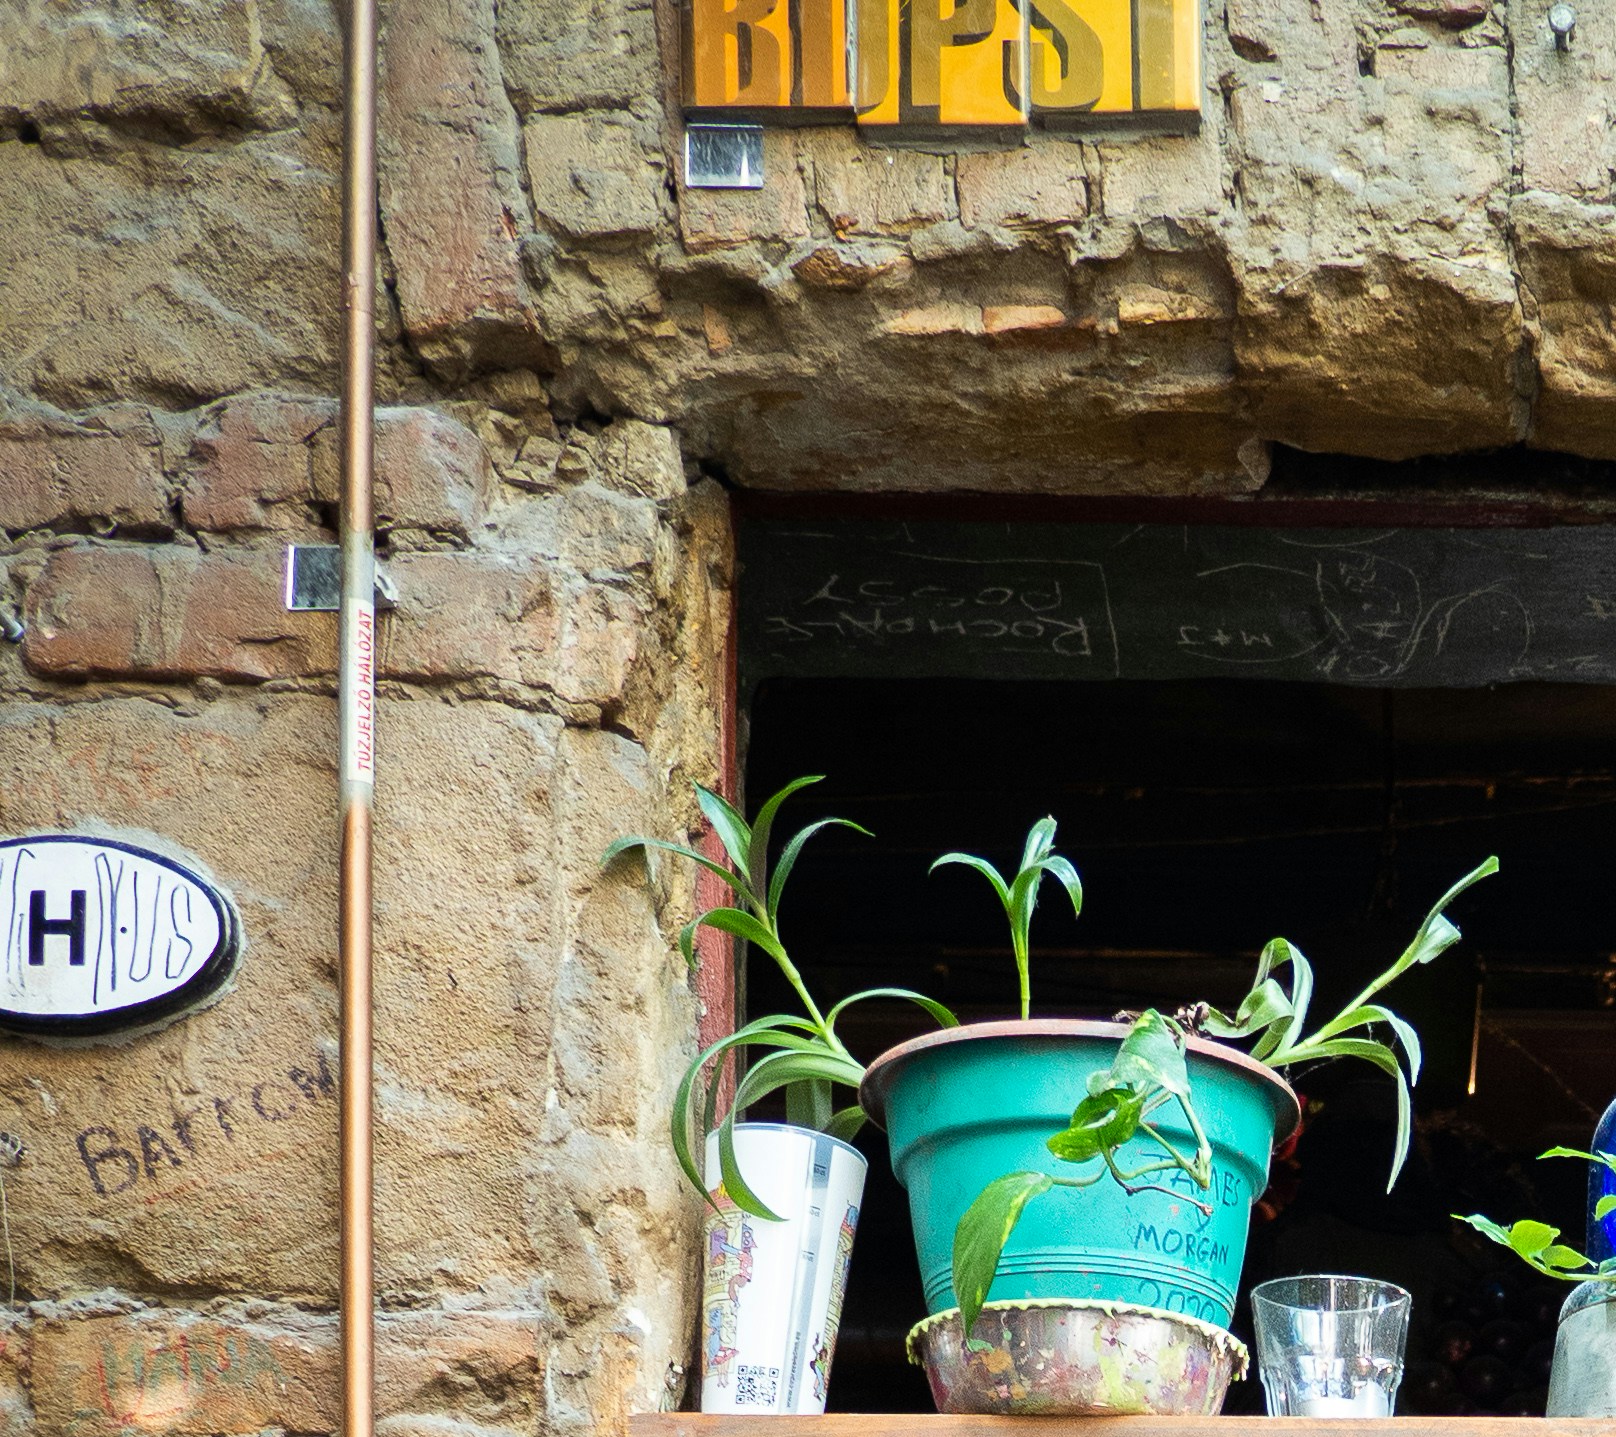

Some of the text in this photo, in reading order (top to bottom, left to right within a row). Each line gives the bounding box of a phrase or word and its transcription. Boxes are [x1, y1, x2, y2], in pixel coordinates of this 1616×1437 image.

[353, 609, 372, 685] HÁLÓZAT
[29, 890, 86, 966] H
[1133, 1222, 1230, 1266] MORGAN
